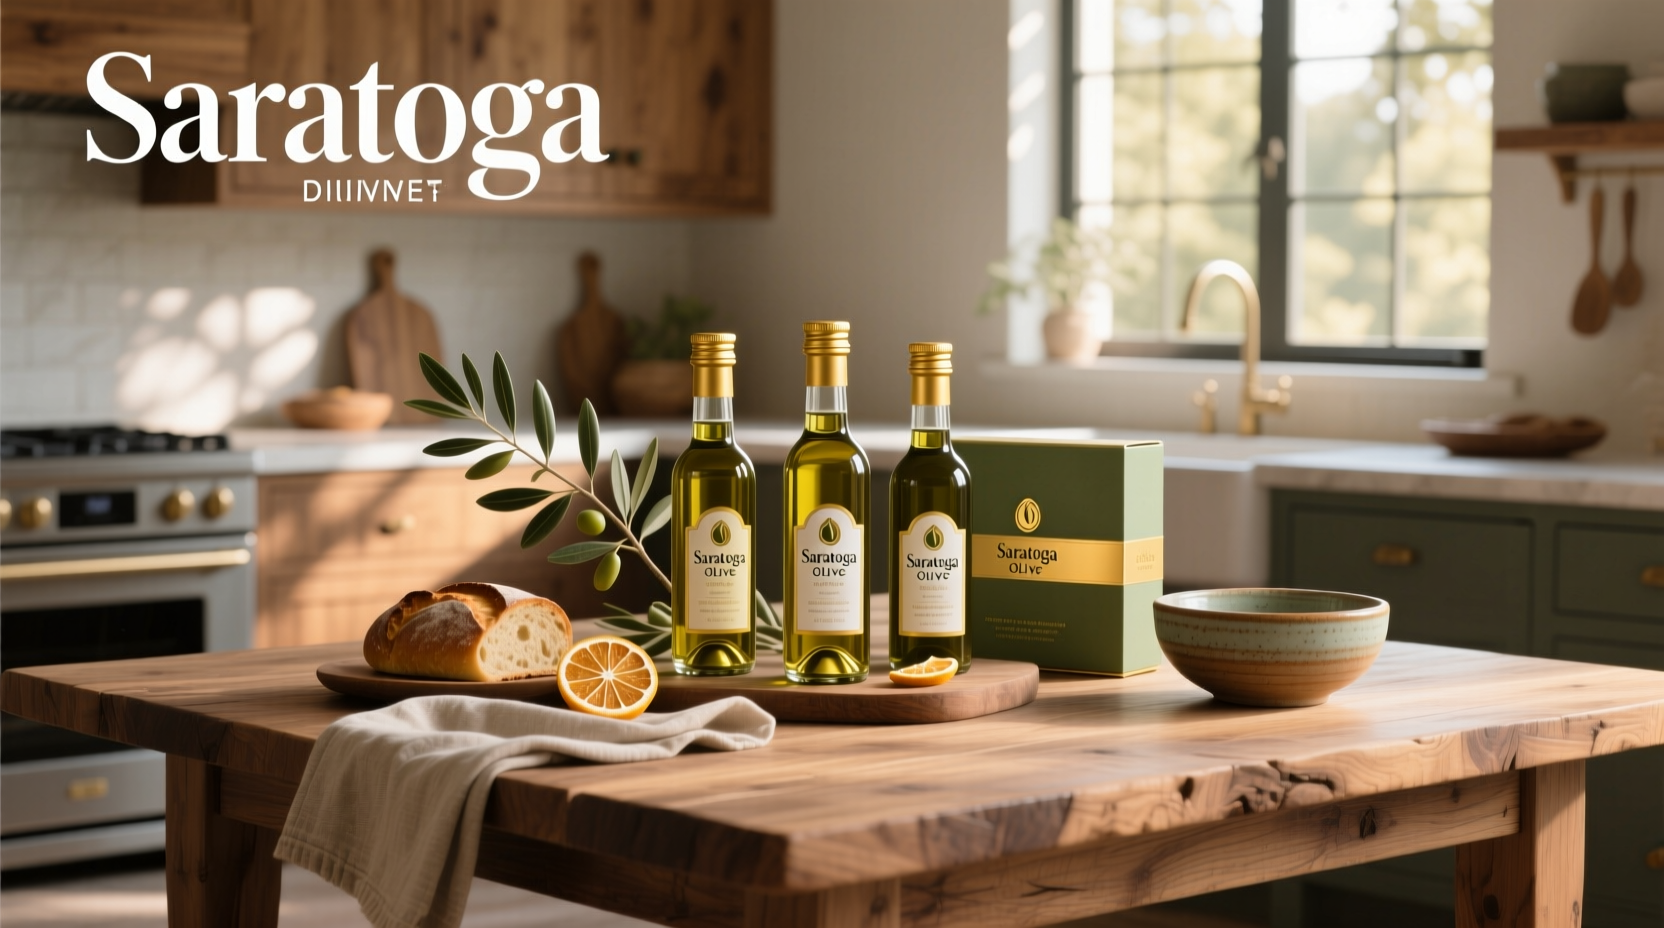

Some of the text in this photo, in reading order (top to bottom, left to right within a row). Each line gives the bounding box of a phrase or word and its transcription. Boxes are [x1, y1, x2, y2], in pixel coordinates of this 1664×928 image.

[693, 549, 746, 567] Saratoga
[801, 548, 857, 567] Saratoga
[997, 542, 1058, 565] Saratoga
